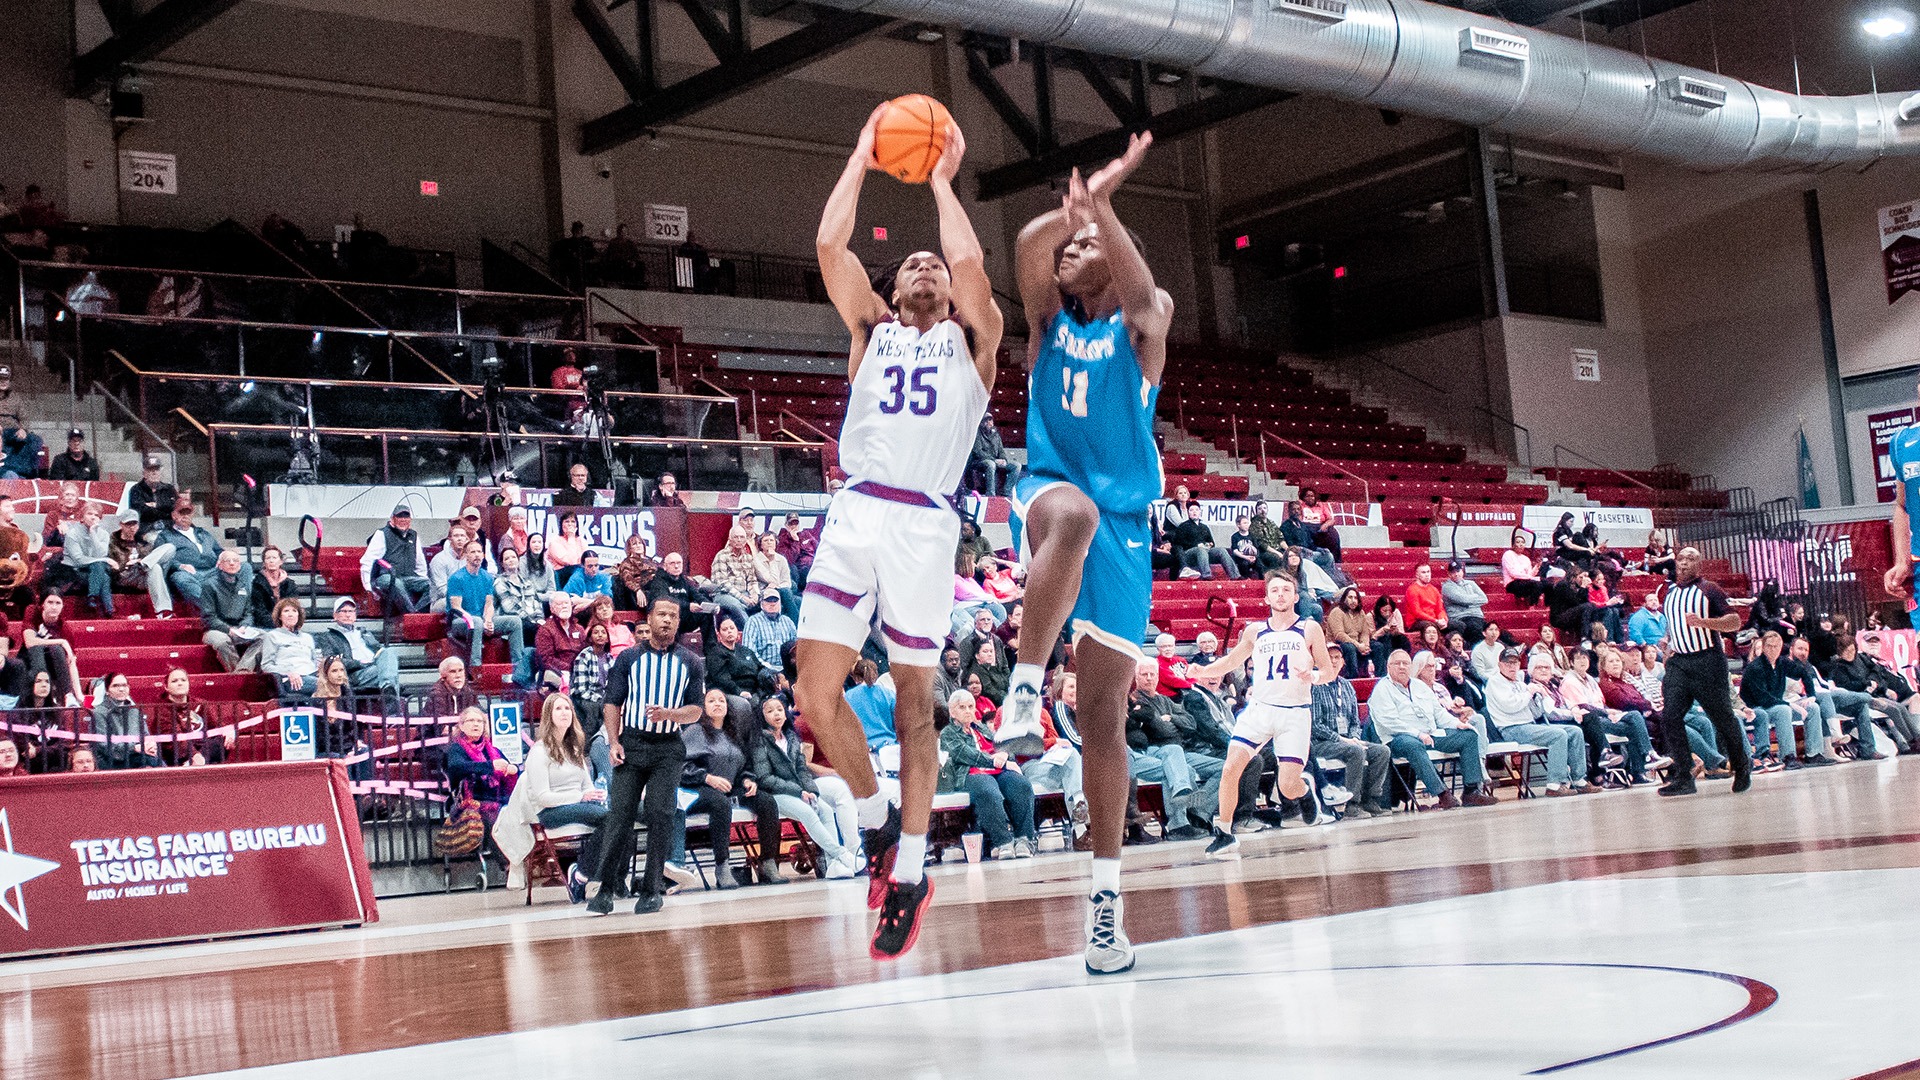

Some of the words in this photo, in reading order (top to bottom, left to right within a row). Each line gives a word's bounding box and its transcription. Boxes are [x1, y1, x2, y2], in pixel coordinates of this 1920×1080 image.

[133, 172, 165, 189] 204
[1890, 206, 1912, 216] COACH
[656, 223, 680, 237] 203
[1579, 365, 1594, 377] 201
[879, 365, 938, 416] 35
[1475, 512, 1516, 521] BUFFALOES
[1597, 513, 1644, 524] BASKETBALL
[1278, 641, 1301, 652] TEXAS
[1266, 654, 1290, 681] 14
[70, 836, 154, 863] TEXAS
[157, 830, 228, 858] FARM
[229, 823, 328, 852] BUREAU
[87, 887, 116, 900] AUTO
[125, 885, 157, 898] HOME
[166, 883, 188, 895] LIFE
